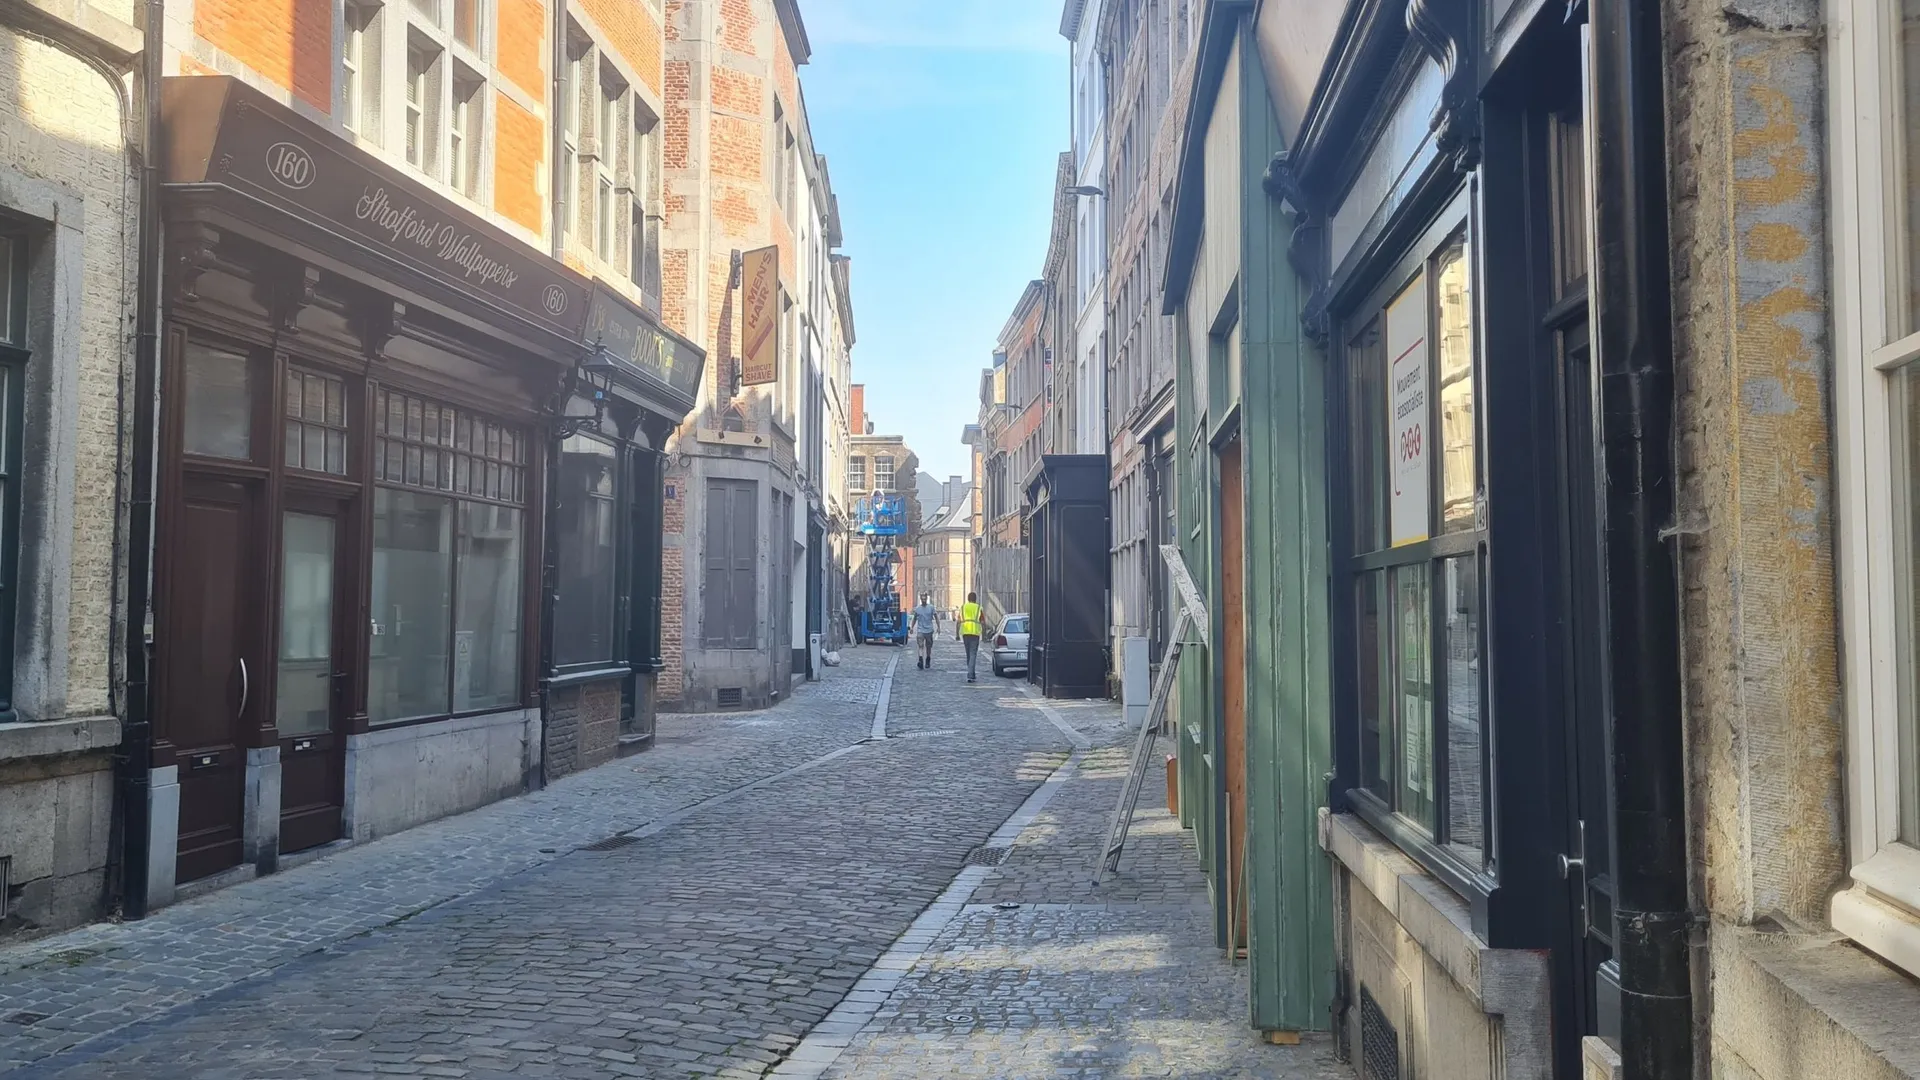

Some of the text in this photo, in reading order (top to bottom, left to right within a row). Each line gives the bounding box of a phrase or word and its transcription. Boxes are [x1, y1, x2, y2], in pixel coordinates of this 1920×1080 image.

[274, 147, 309, 184] 160
[438, 225, 518, 288] Wallpapers
[747, 251, 772, 304] MEN'S
[546, 287, 565, 312] 160
[748, 286, 770, 330] HAIR
[745, 363, 772, 373] HAIRCUT
[745, 370, 772, 382] SHAVE
